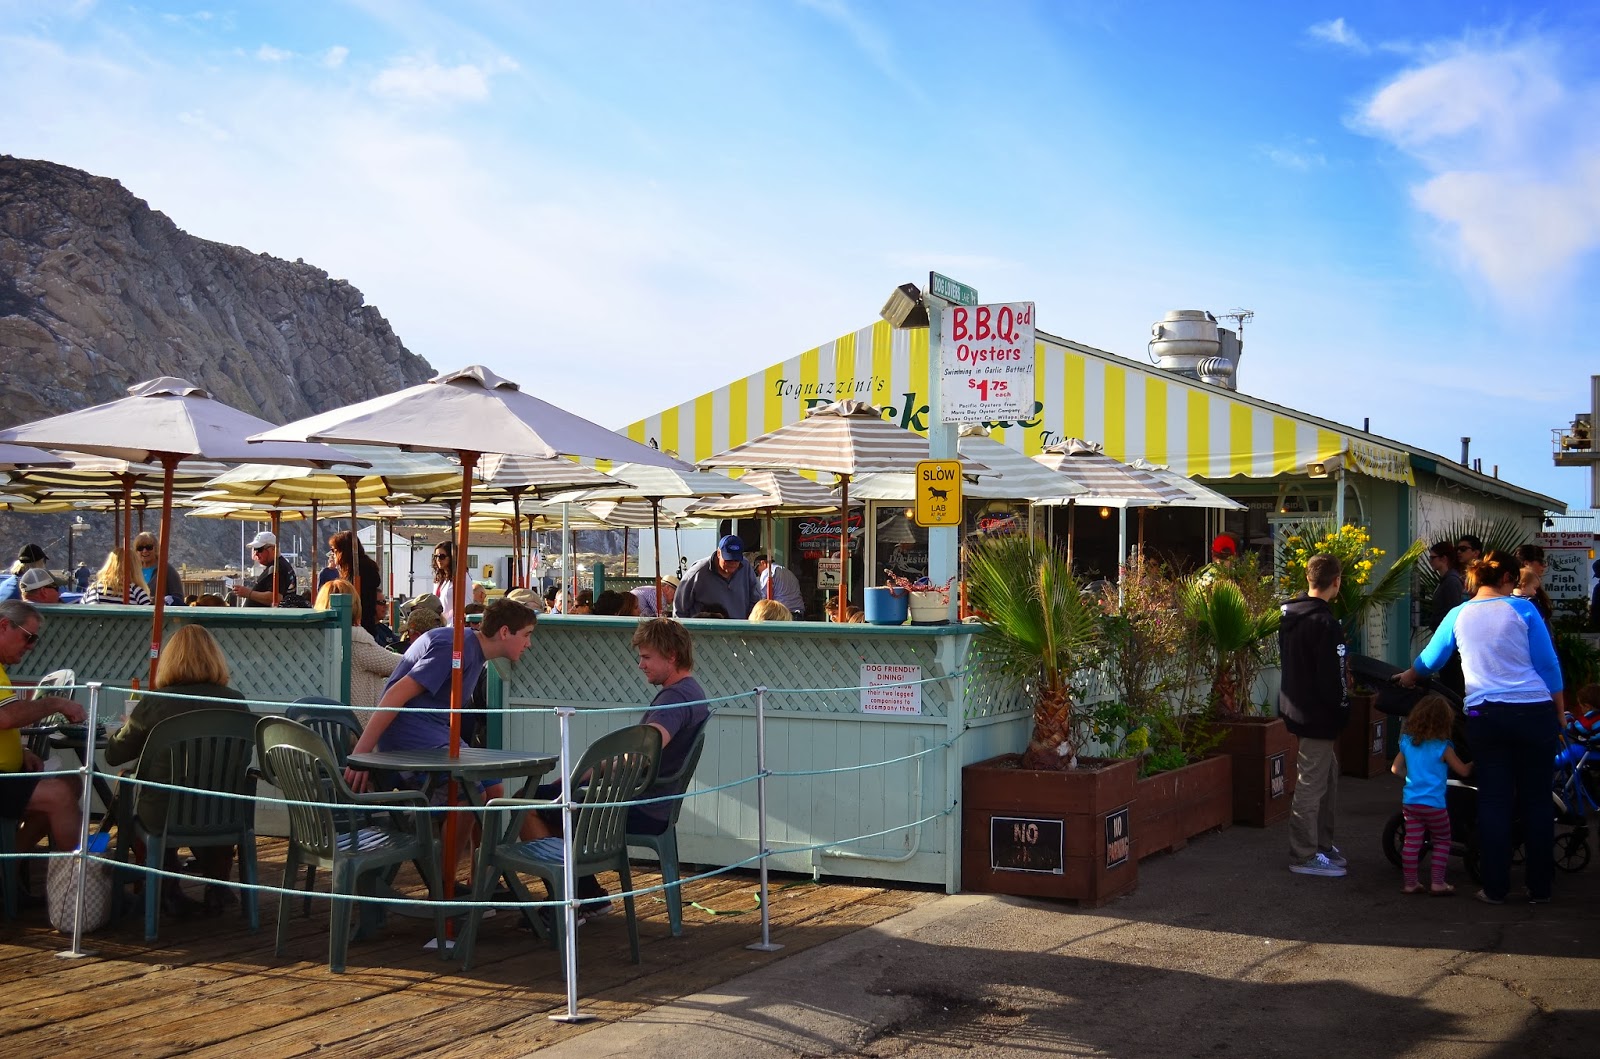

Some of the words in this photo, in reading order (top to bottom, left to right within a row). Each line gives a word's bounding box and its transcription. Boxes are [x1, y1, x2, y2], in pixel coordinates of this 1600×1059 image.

[935, 277, 945, 294] DOG
[945, 280, 961, 301] LOVERS
[957, 344, 1021, 366] Oysters
[944, 368, 972, 376] Swimming
[775, 376, 885, 399] Tognazzini's
[923, 469, 955, 480] SLOW
[889, 553, 928, 563] Docksid
[1544, 583, 1582, 592] Market
[885, 665, 916, 673] FRIENDLY
[865, 704, 897, 712] accompany
[1113, 816, 1123, 838] NO
[1013, 823, 1039, 844] NO
